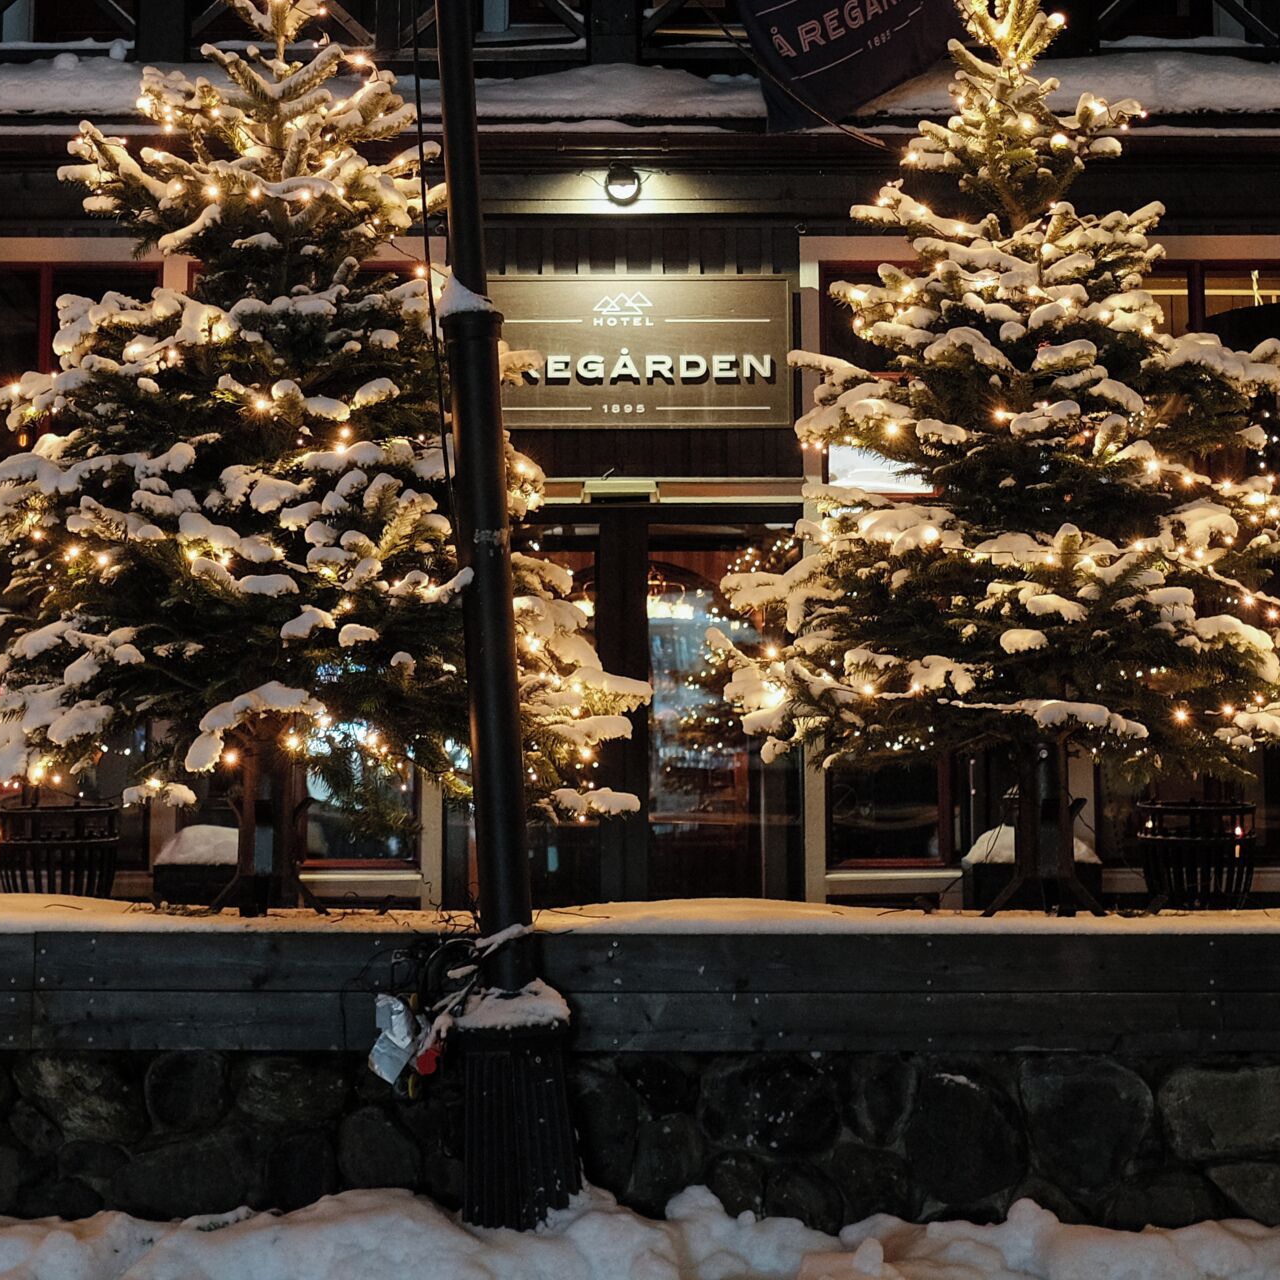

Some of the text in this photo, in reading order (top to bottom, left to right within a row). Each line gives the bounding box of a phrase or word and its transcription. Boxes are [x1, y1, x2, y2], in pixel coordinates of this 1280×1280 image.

[592, 316, 654, 327] HOTEL
[522, 346, 773, 382] EGÅRDEN
[601, 403, 646, 414] 1895
